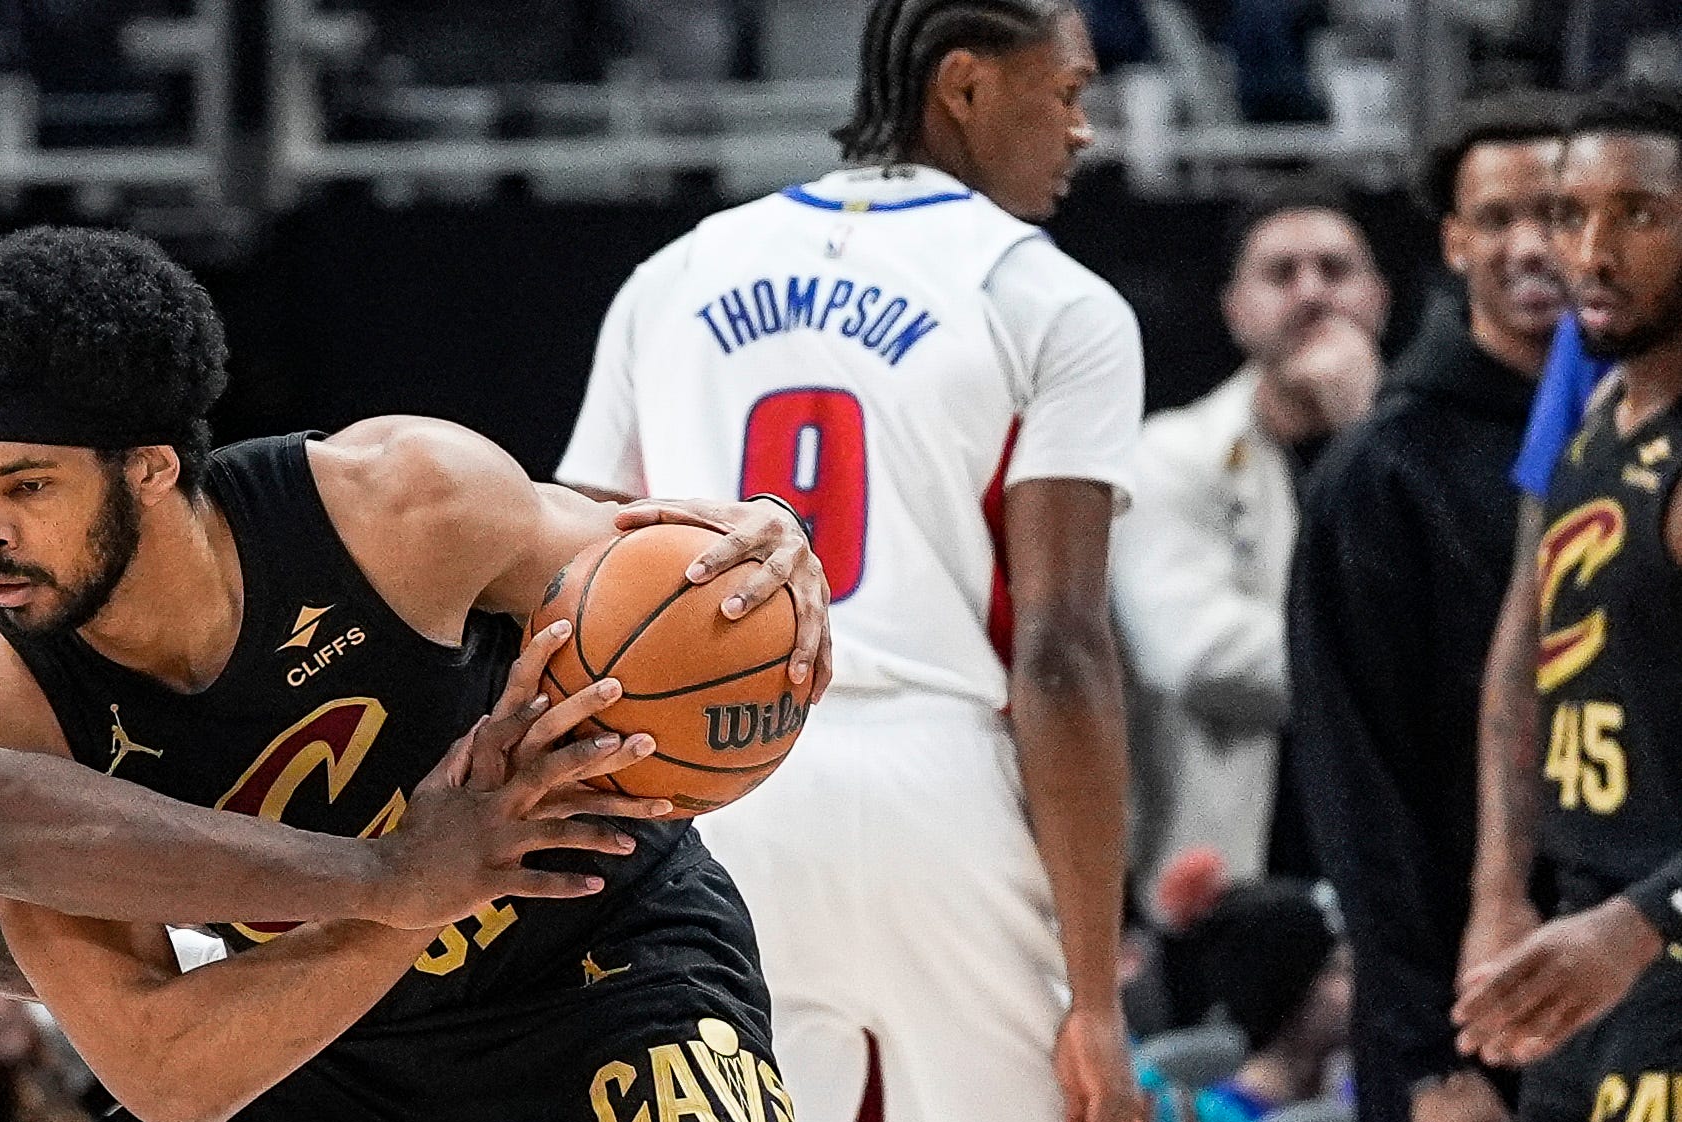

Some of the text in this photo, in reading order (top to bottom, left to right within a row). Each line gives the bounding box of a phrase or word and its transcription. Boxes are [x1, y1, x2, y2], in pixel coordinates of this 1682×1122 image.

[695, 276, 939, 367] THOMPSON
[739, 386, 869, 604] 9
[287, 627, 365, 687] CLIFFS
[1544, 700, 1628, 815] 45
